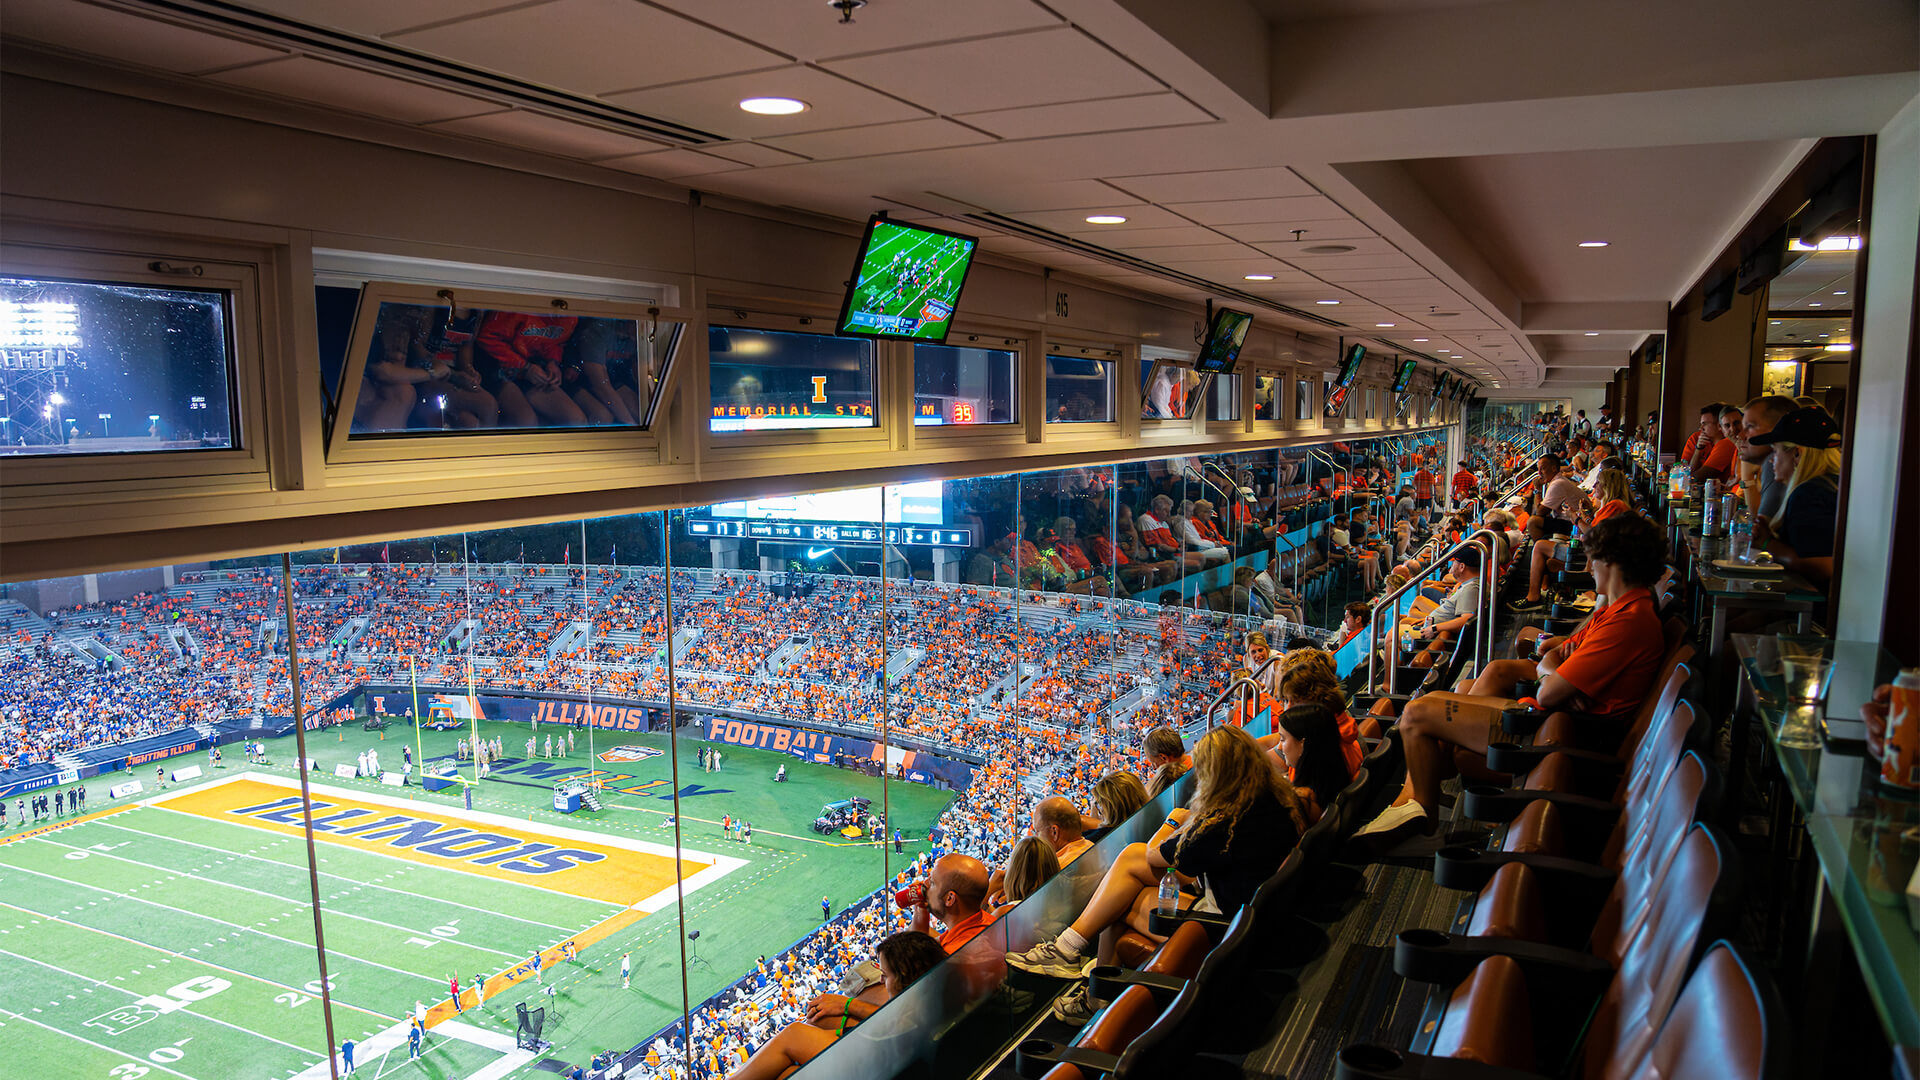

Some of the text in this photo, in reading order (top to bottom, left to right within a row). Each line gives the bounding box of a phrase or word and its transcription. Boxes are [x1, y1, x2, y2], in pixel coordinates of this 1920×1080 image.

[1055, 291, 1069, 318] 615
[811, 376, 827, 403] I
[713, 406, 811, 416] MEMORIAL
[813, 526, 838, 540] 8:46
[537, 702, 643, 730] ILLINOIS
[170, 743, 196, 755] ILLINI
[226, 796, 607, 875] ILLINOIS
[403, 925, 460, 949] 10
[274, 978, 338, 1008] 20
